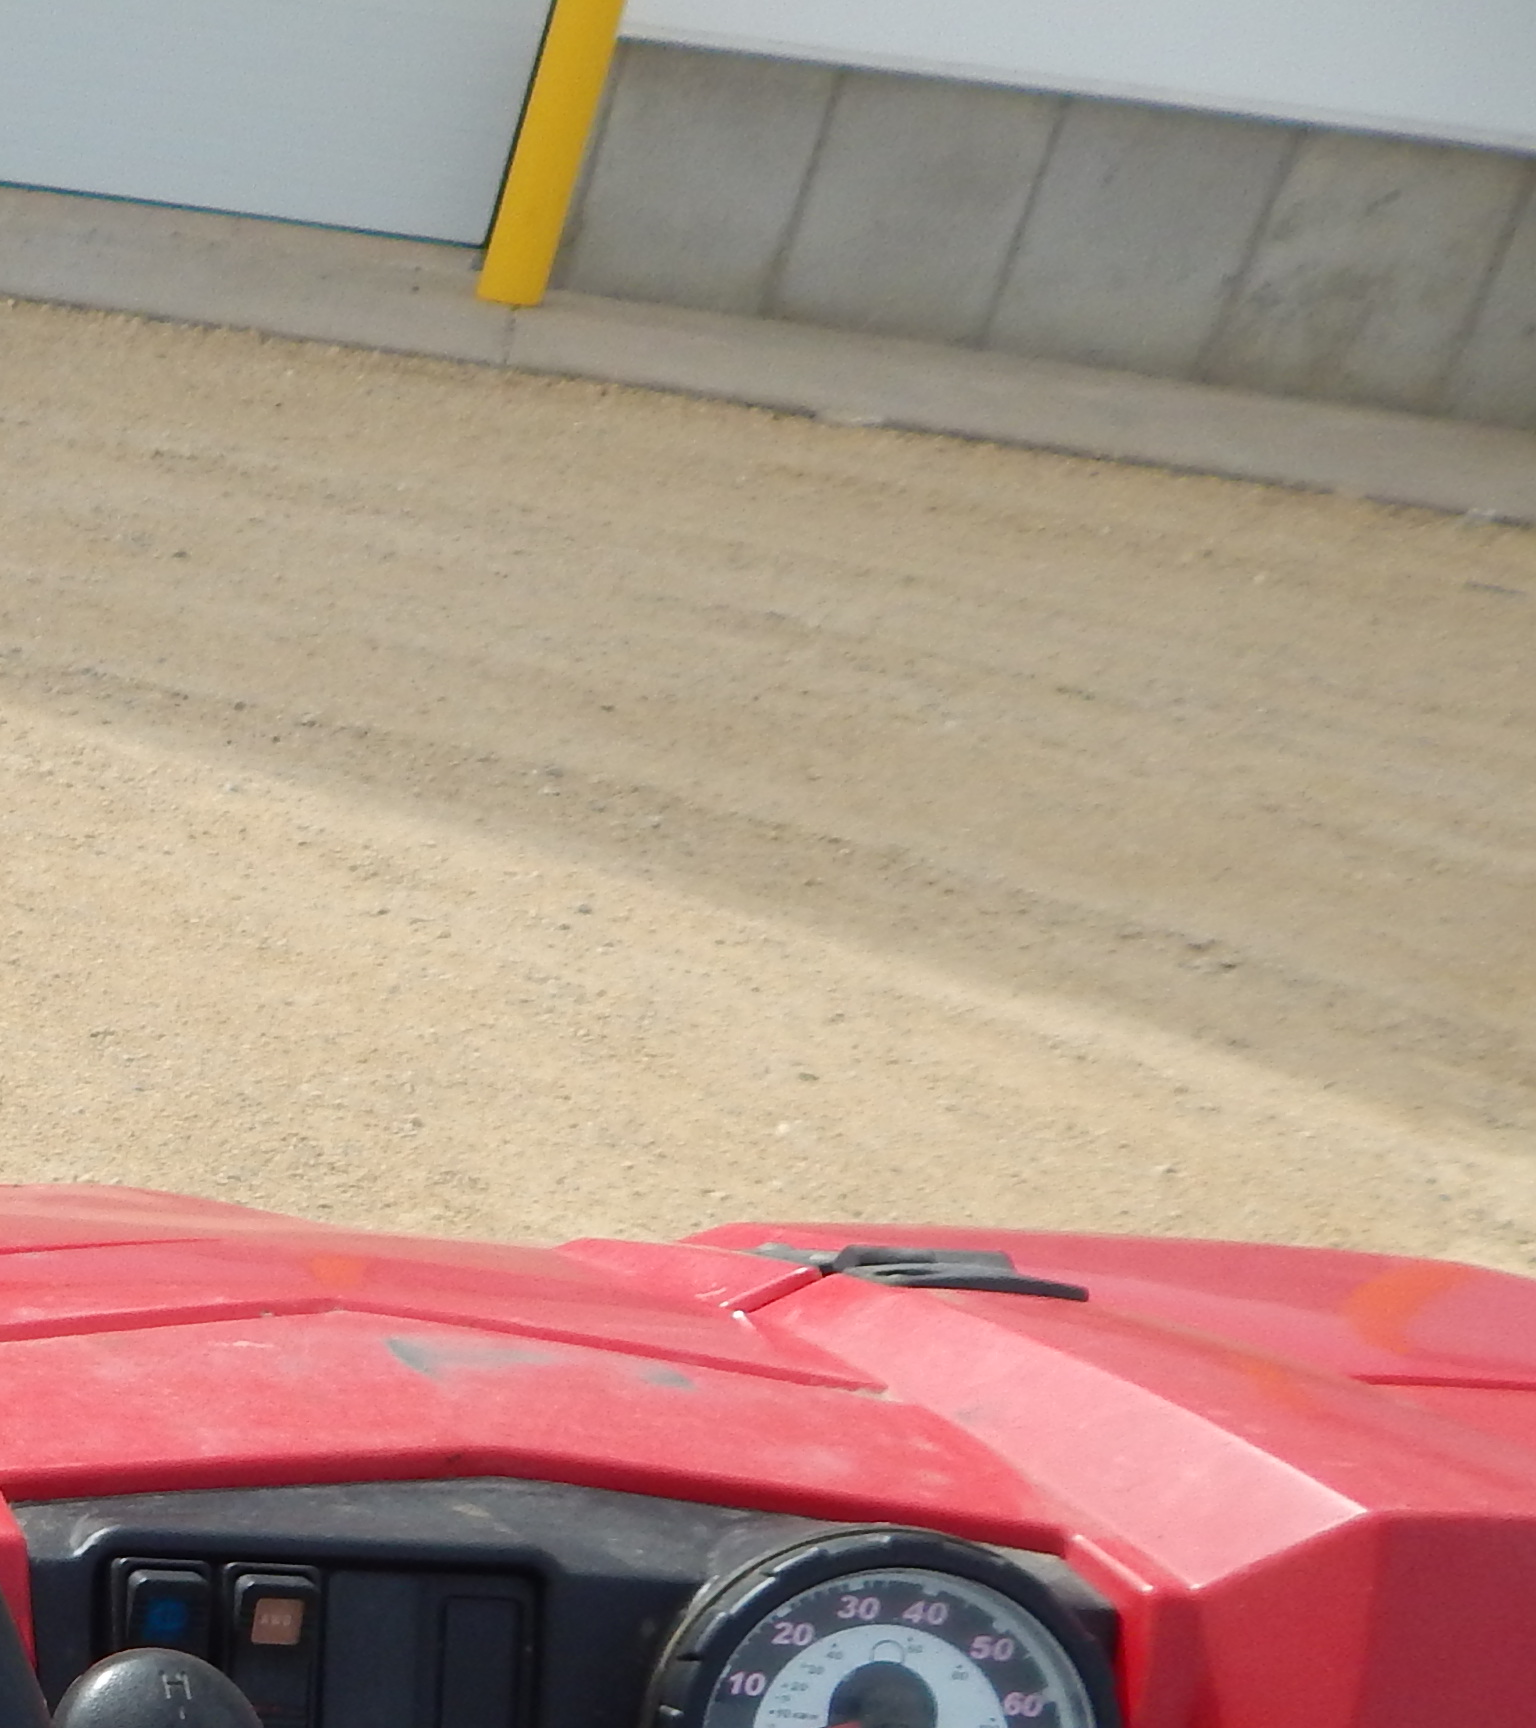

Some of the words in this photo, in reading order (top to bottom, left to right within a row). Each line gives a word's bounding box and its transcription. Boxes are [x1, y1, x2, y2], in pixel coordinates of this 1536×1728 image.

[836, 1595, 881, 1620] 30
[902, 1600, 949, 1626] 40
[771, 1621, 815, 1646] 20
[970, 1635, 1015, 1661] 50
[158, 1669, 193, 1700] H
[729, 1671, 766, 1696] 10
[1003, 1691, 1045, 1718] 60
